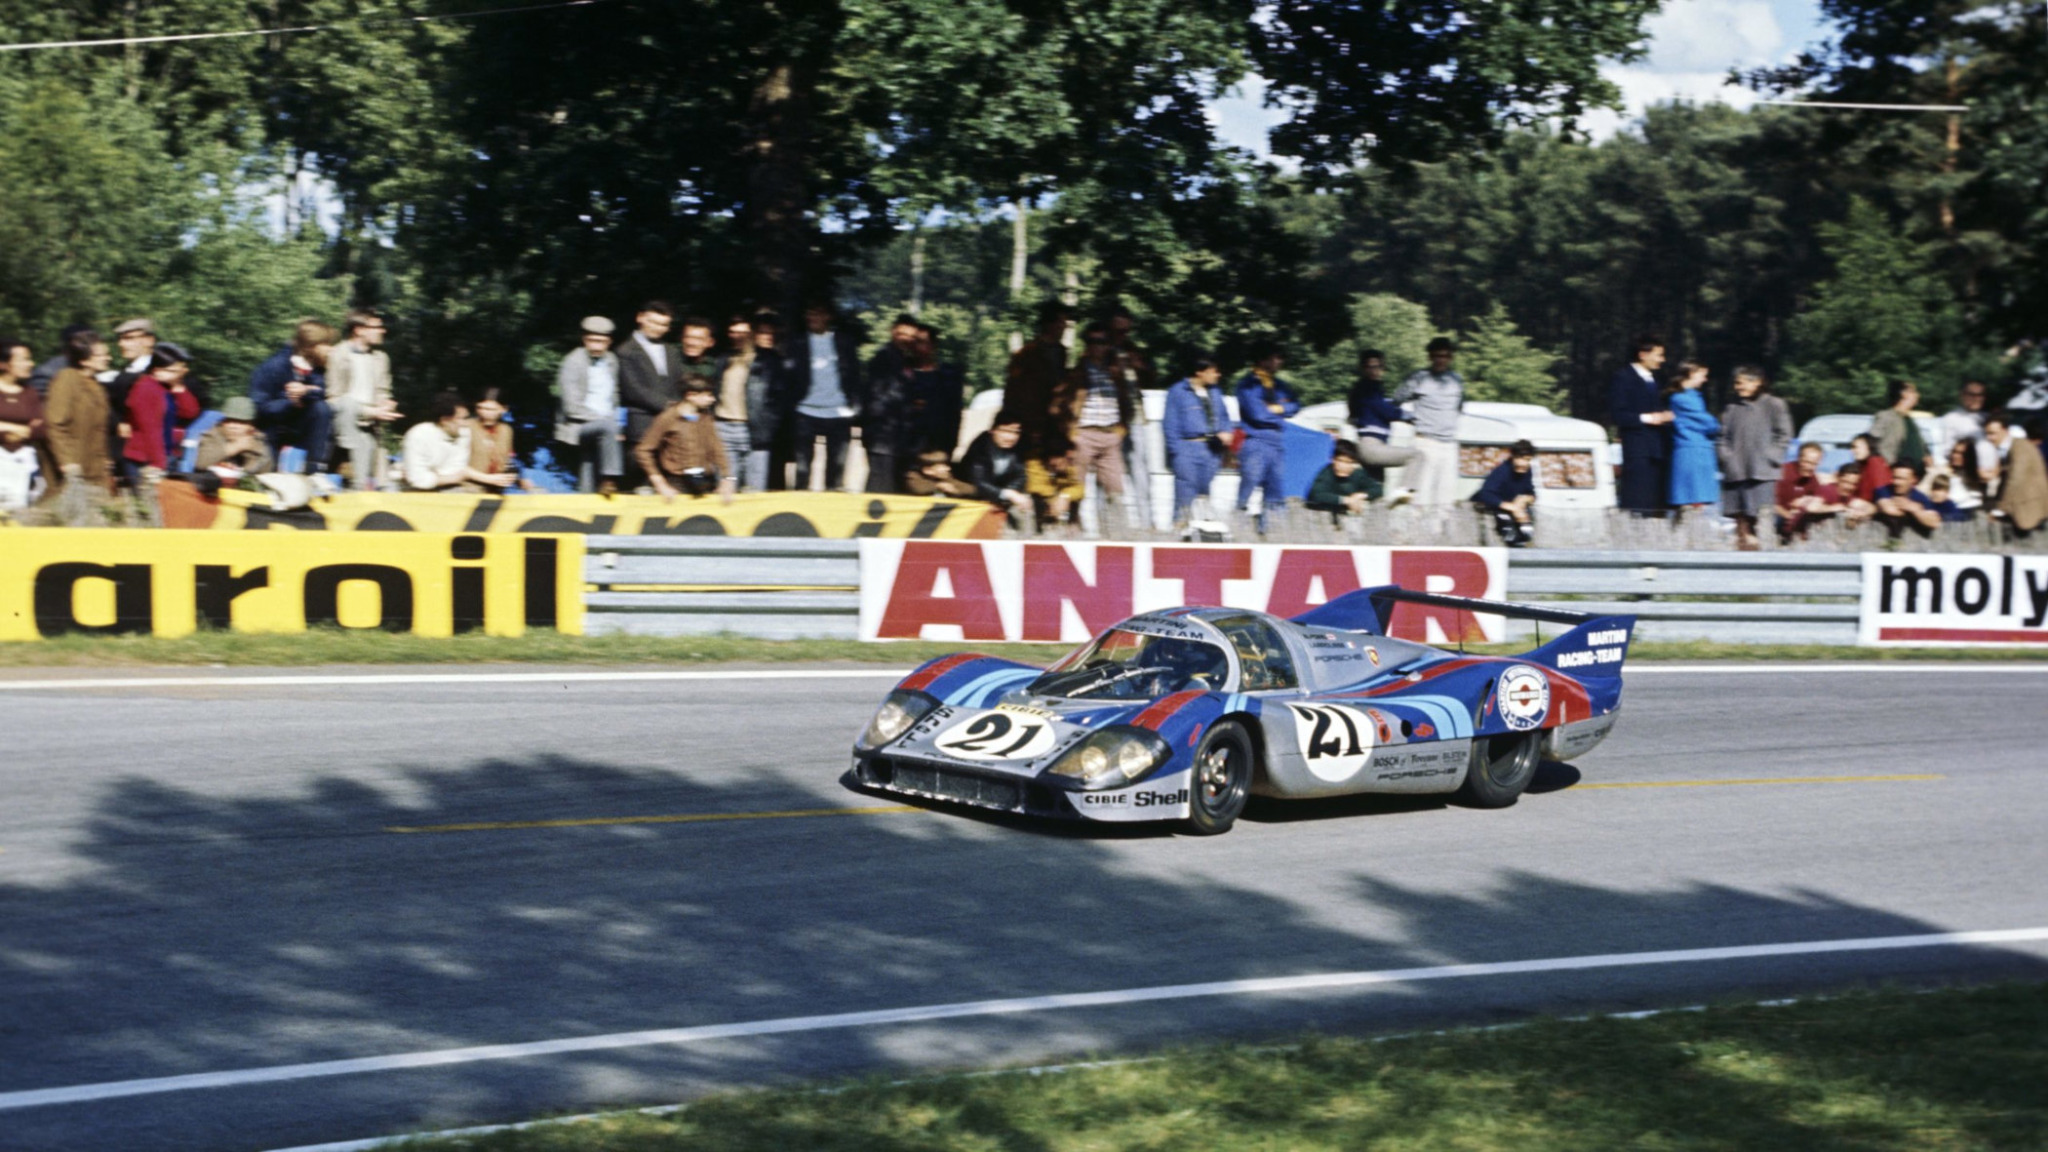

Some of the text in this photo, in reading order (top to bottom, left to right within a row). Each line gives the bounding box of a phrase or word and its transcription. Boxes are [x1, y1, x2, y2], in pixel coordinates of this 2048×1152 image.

[876, 541, 1489, 643] ANTAR
[1588, 629, 1627, 646] MARTINI
[1557, 647, 1622, 668] RACING-TEAM
[940, 713, 1043, 757] 21
[1290, 705, 1364, 759] 21
[1084, 789, 1188, 807] CIBIE Shell
